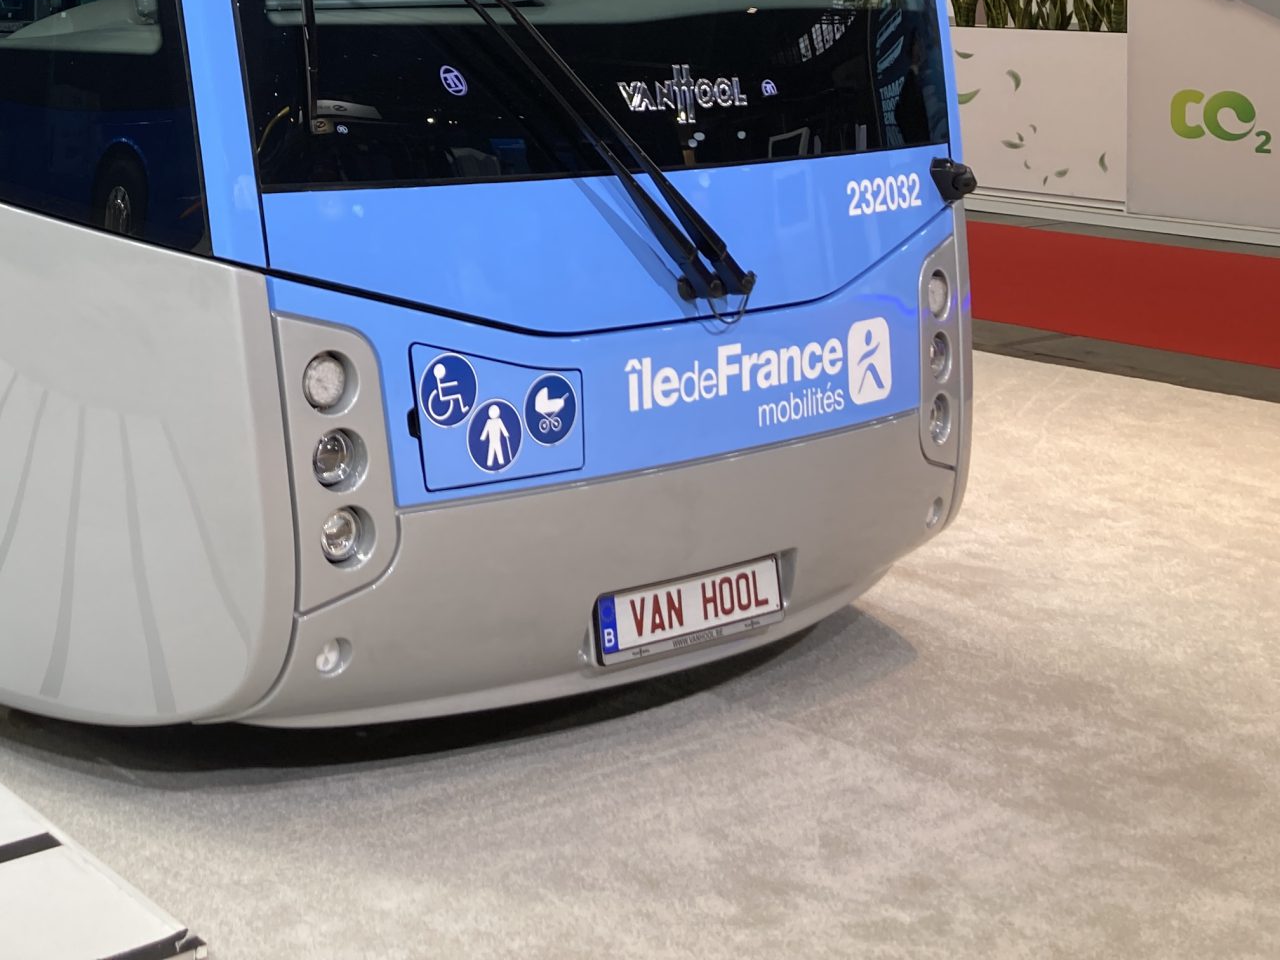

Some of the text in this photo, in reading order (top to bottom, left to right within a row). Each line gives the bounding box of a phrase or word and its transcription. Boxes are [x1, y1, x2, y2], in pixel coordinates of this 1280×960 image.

[846, 173, 922, 216] 232032
[757, 383, 845, 427] mobilités
[604, 570, 769, 648] B VAN HOOL
